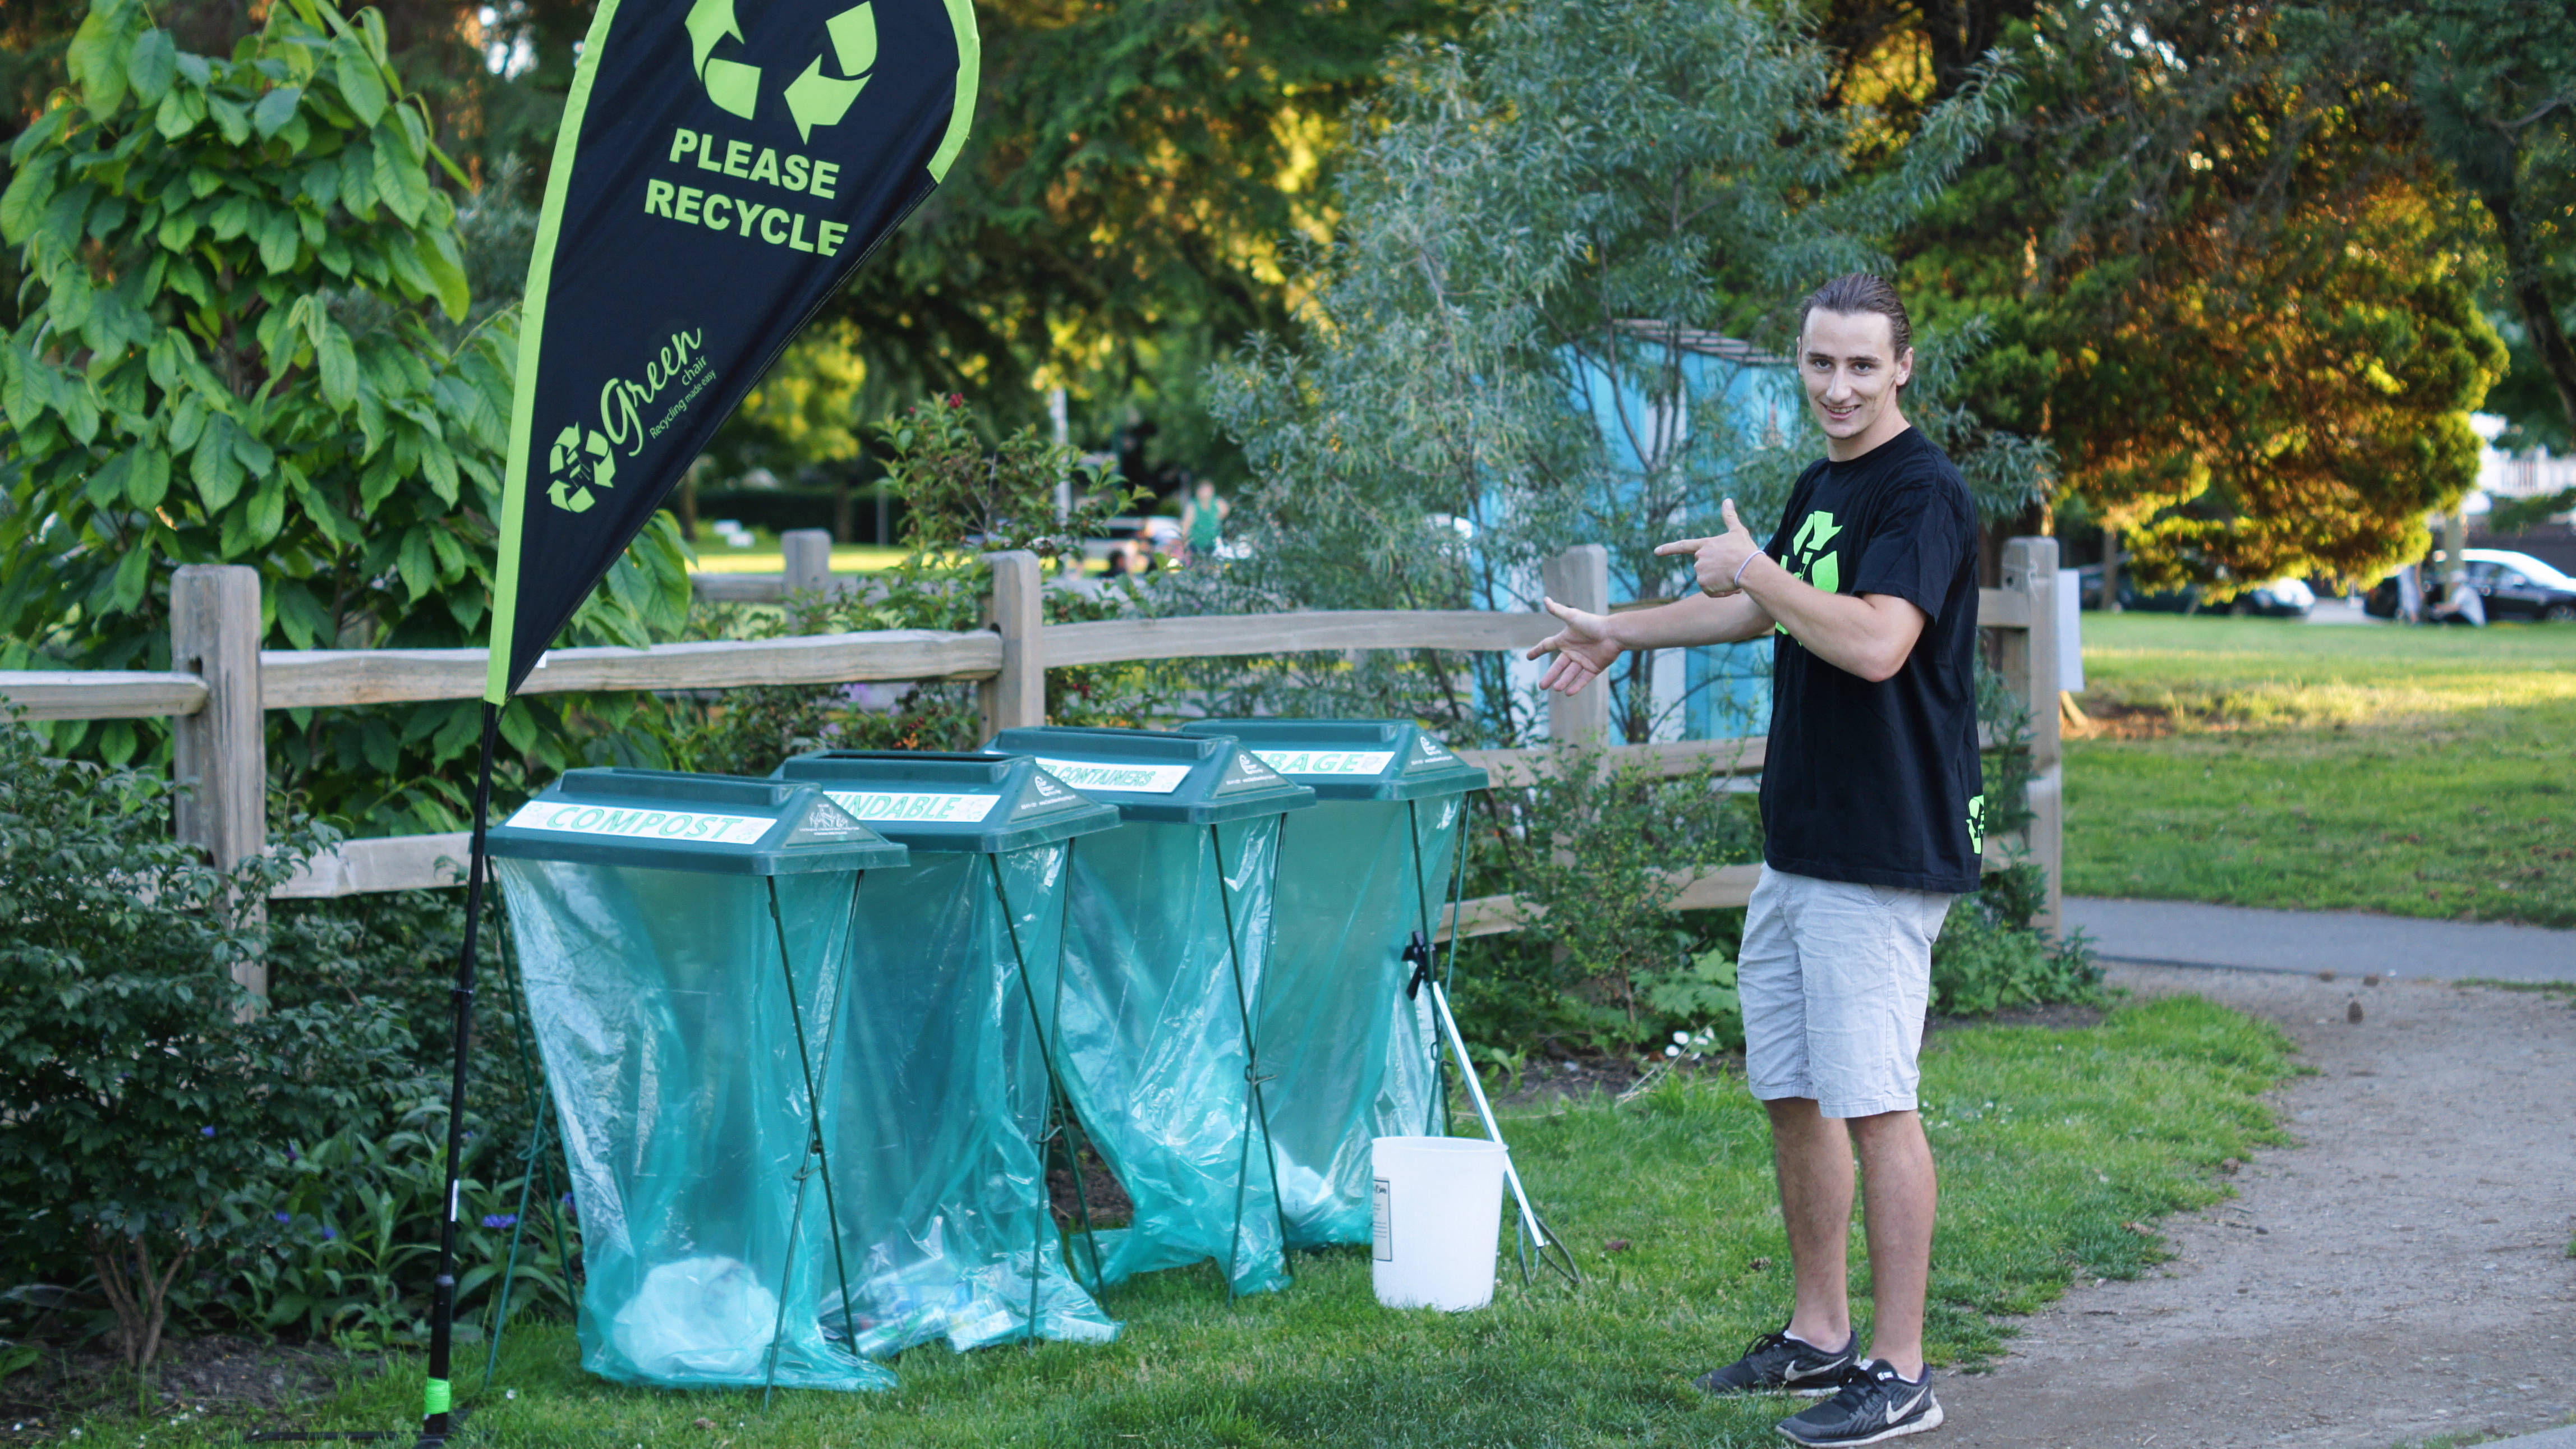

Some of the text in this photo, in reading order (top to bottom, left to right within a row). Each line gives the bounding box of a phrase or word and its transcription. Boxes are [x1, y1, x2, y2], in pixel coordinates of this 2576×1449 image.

[669, 128, 840, 199] PLEASE
[645, 178, 849, 257] RECYCLE
[682, 355, 707, 385] chair
[650, 370, 716, 439] Recycling made easy
[1057, 766, 1156, 786] CONTAINERS
[1254, 753, 1364, 772] BAGE
[827, 794, 962, 820] NDABLE
[546, 807, 744, 839] COMPOST
